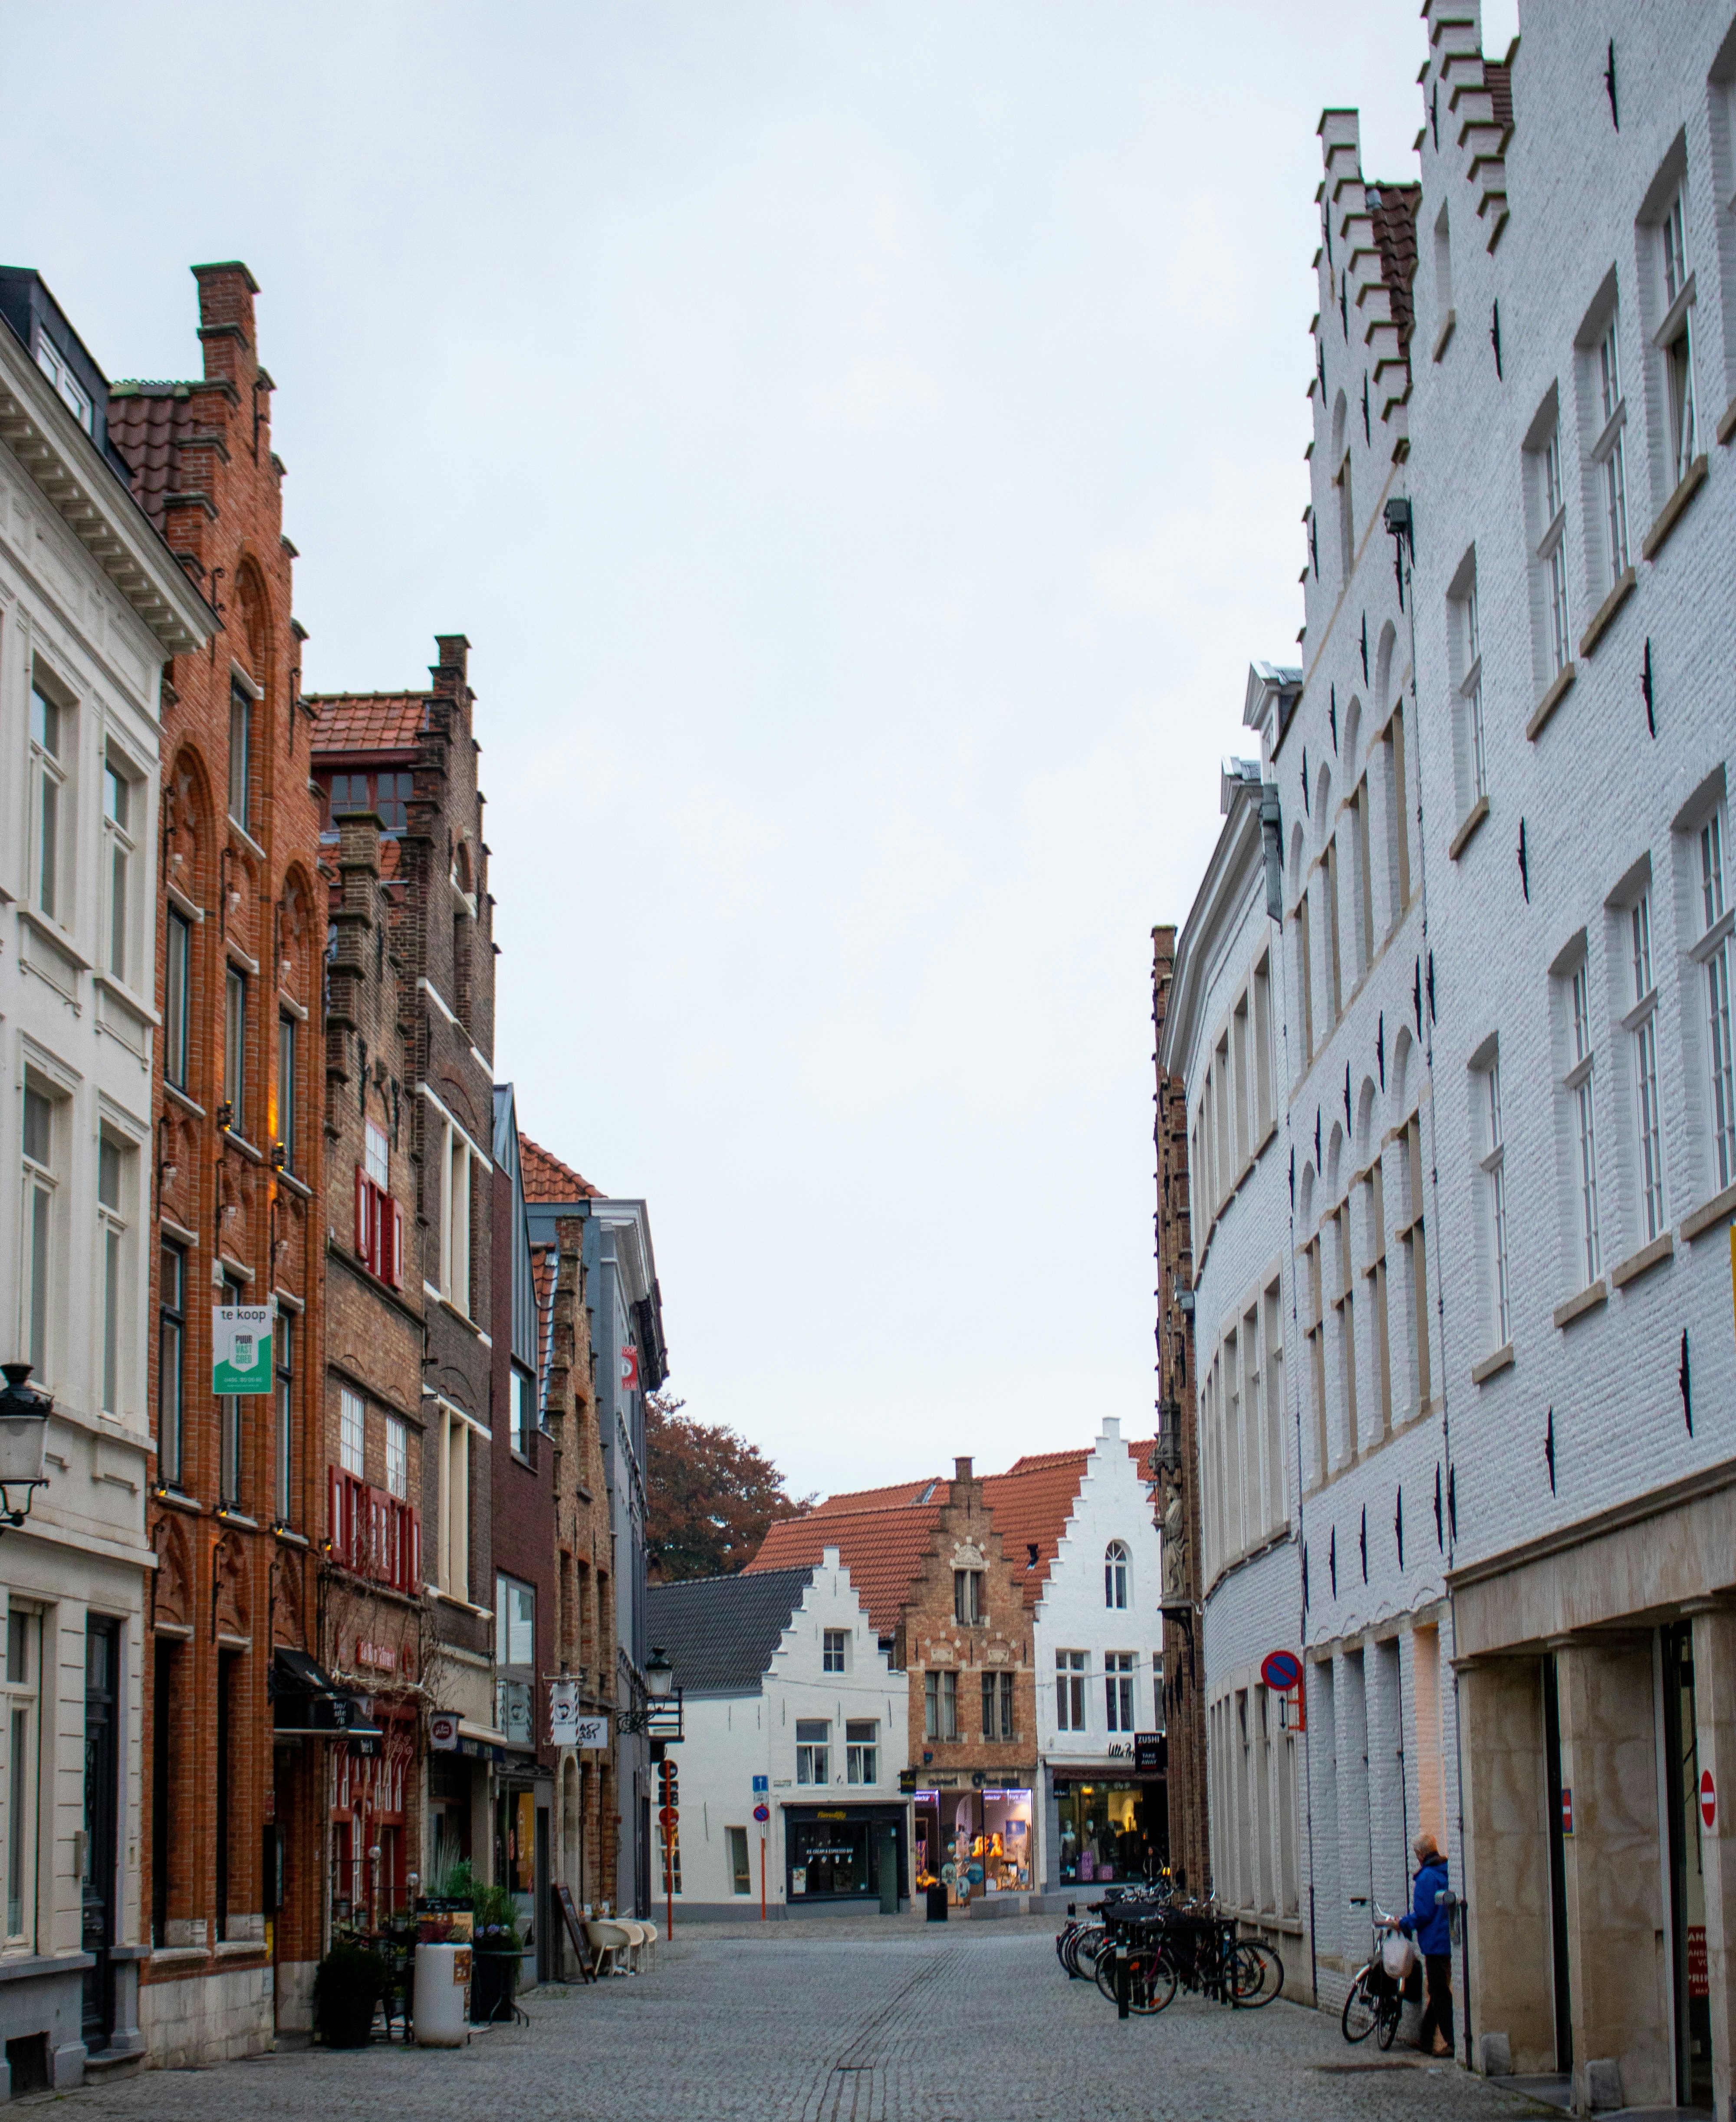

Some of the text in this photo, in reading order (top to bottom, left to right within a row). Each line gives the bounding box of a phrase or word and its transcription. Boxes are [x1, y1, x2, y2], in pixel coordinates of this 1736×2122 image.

[222, 1307, 266, 1323] te koop
[236, 1335, 253, 1344] PUUR
[1138, 1735, 1160, 1744] ZUSHI
